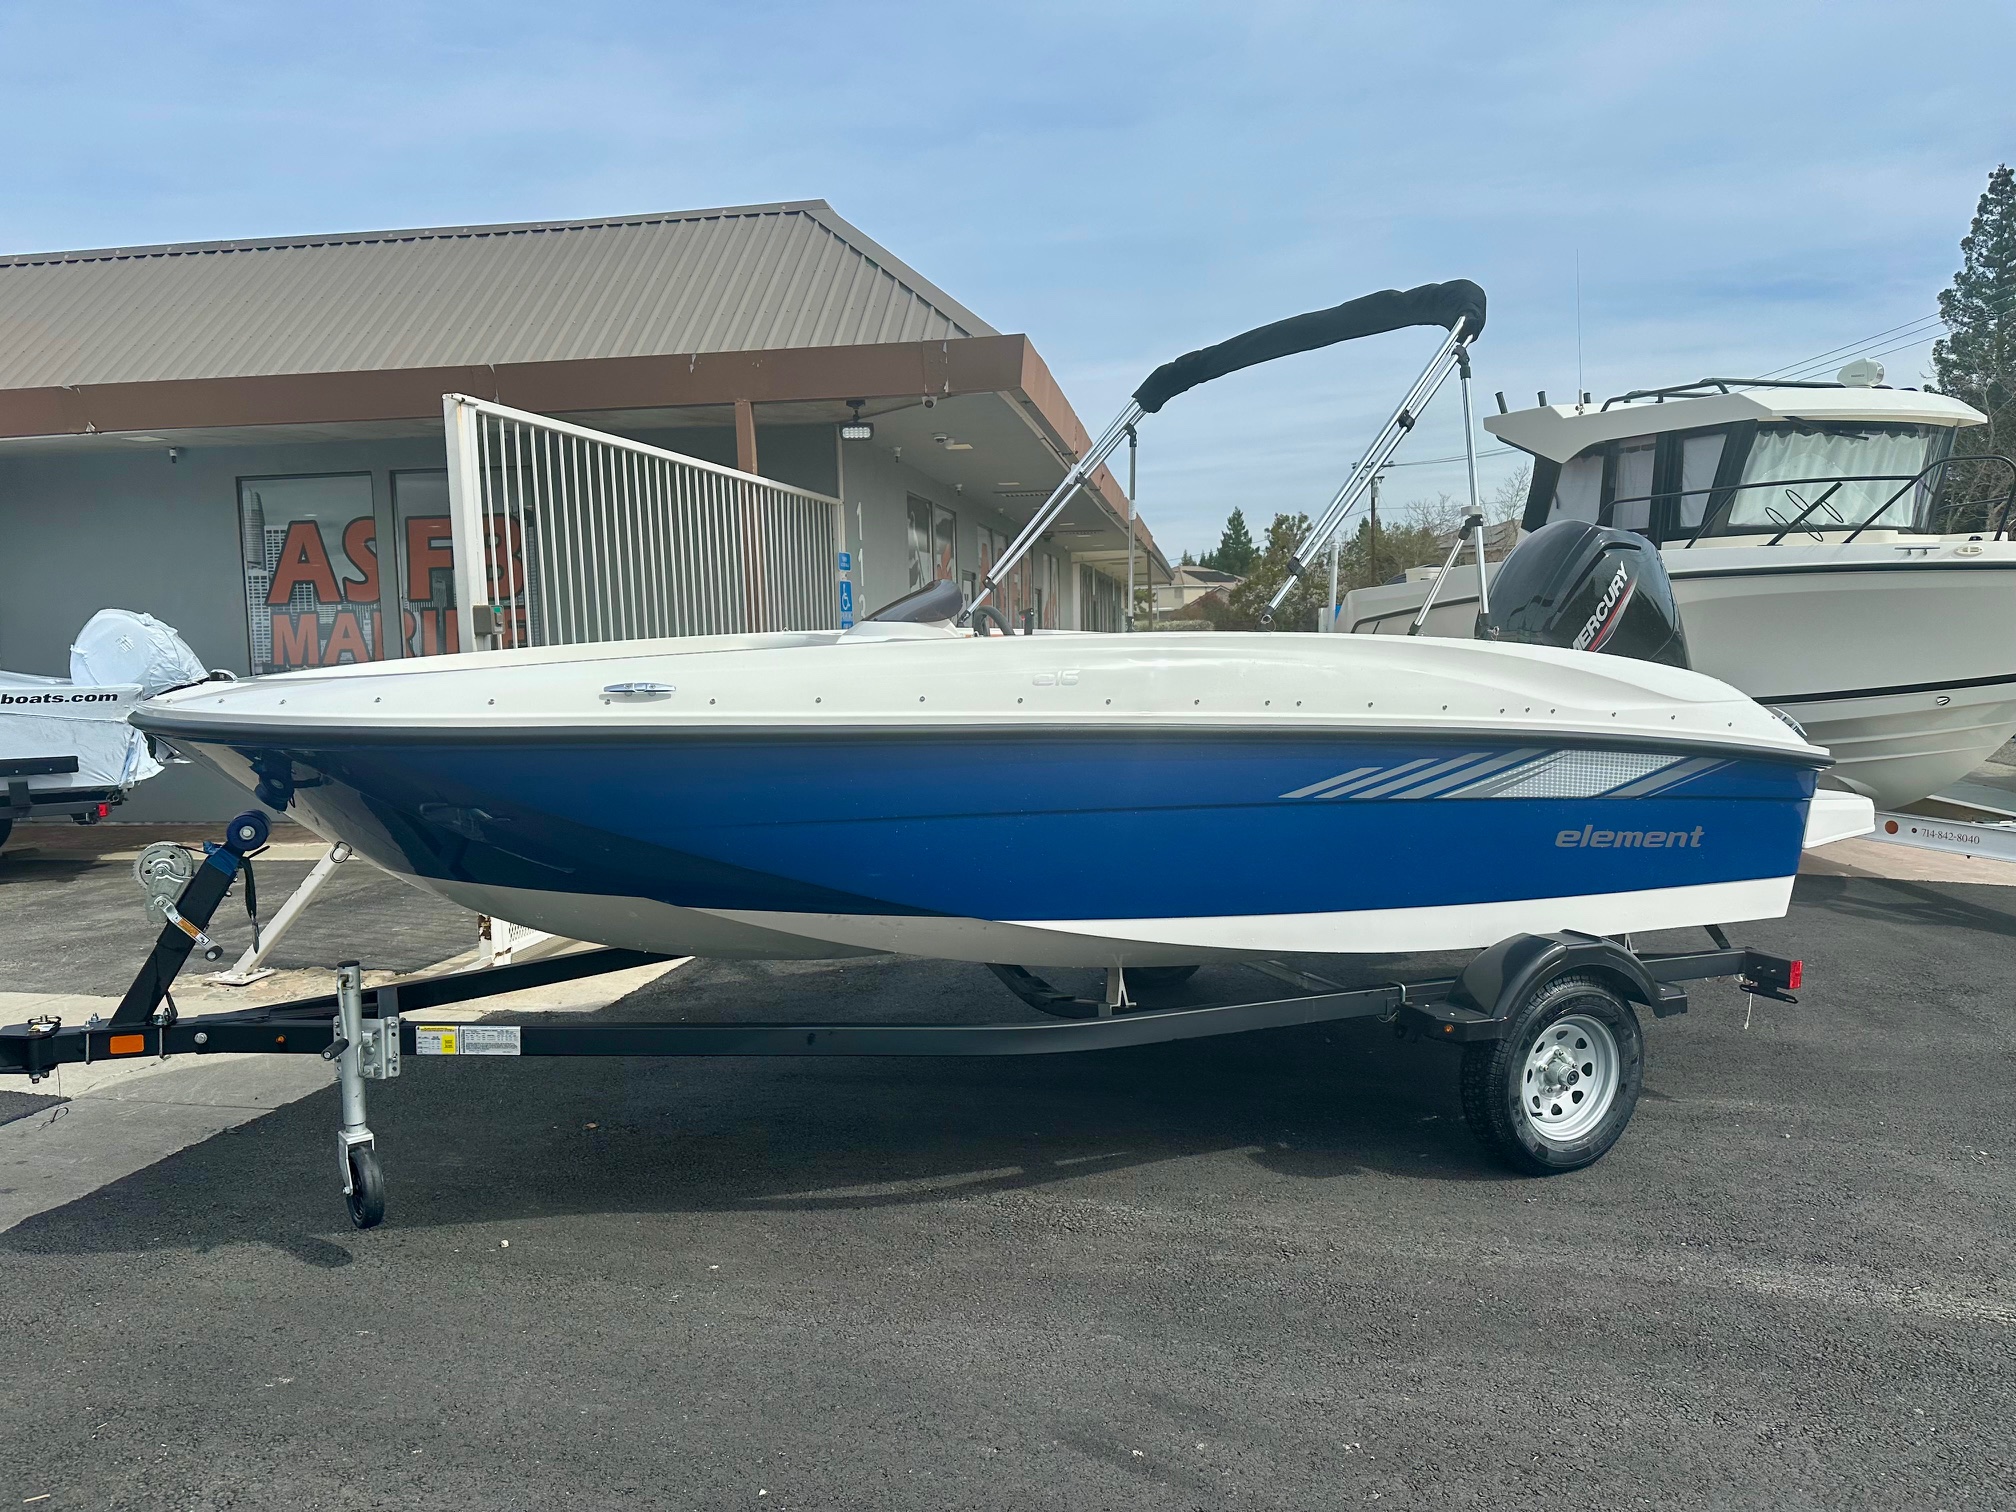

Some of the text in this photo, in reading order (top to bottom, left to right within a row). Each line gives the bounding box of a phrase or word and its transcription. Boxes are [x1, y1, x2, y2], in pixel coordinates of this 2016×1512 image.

[265, 513, 525, 606] ASFB
[0, 693, 119, 705] boats.com
[1554, 824, 1705, 848] element
[1921, 828, 1980, 845] 714-842-8040
